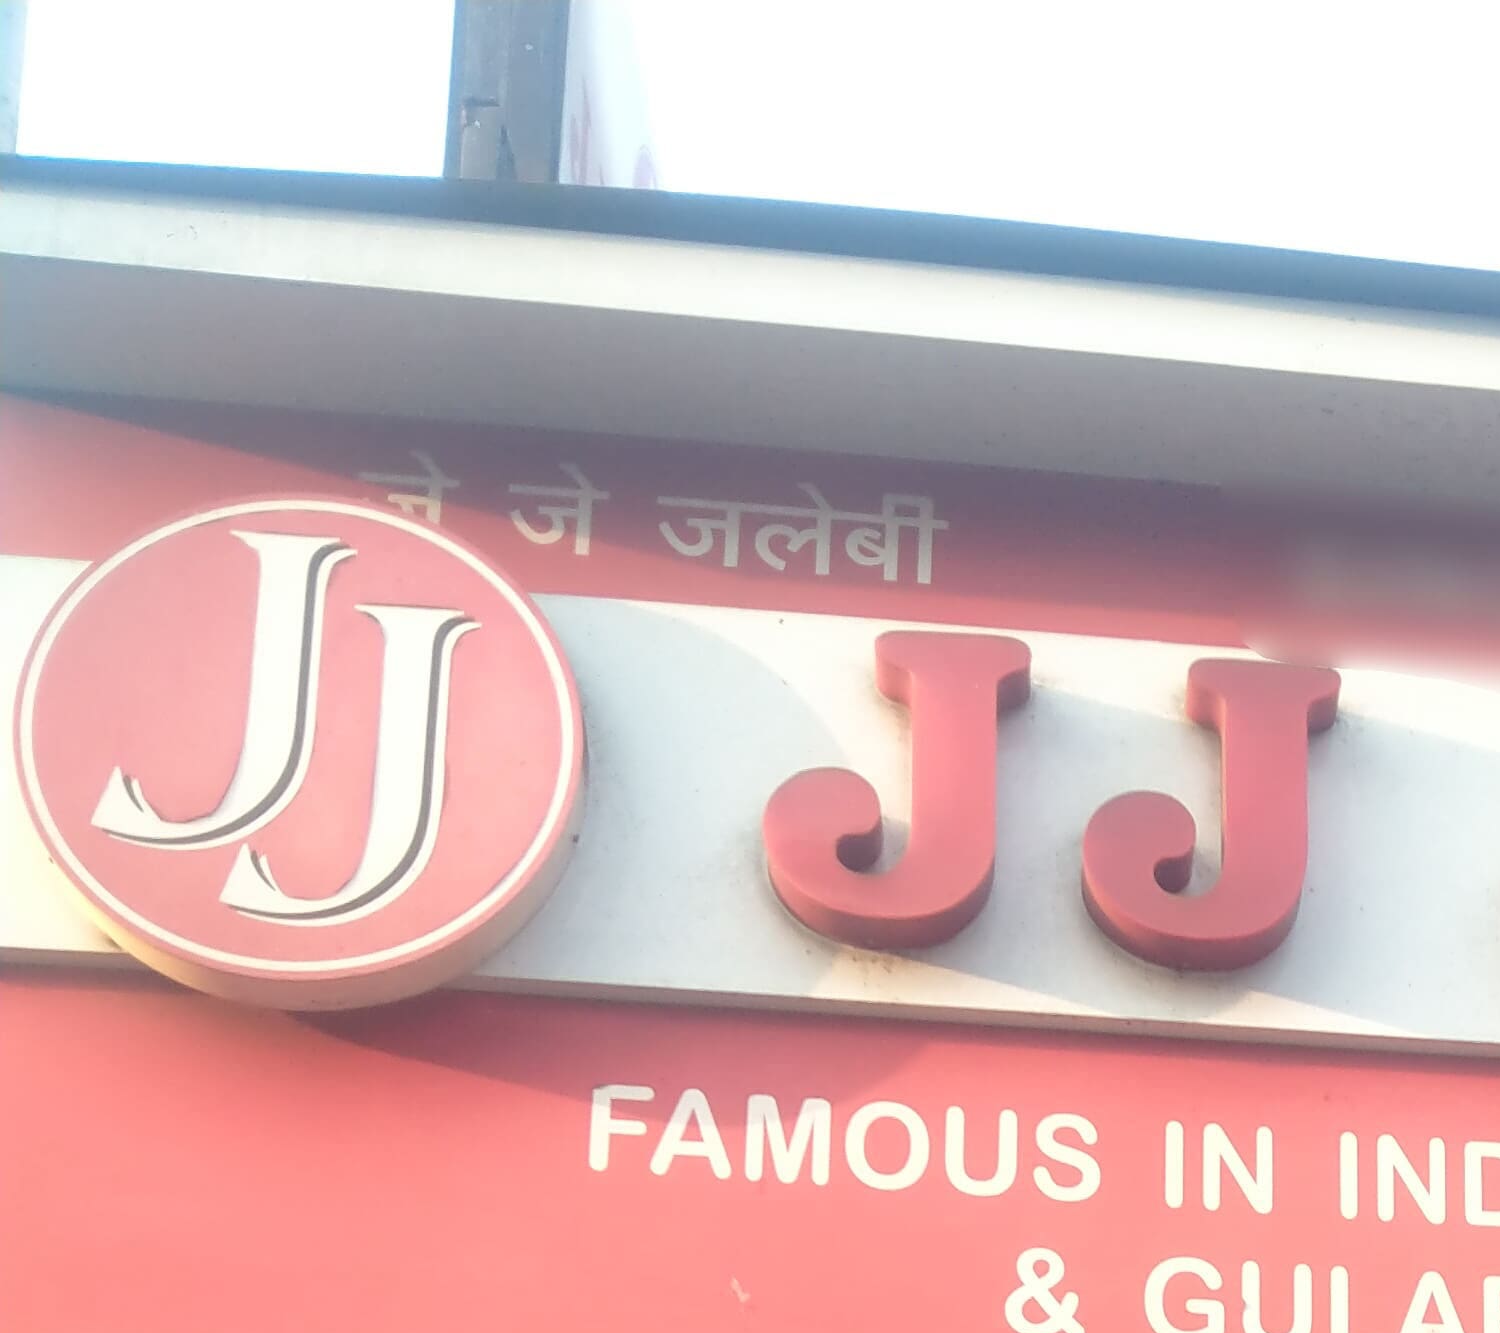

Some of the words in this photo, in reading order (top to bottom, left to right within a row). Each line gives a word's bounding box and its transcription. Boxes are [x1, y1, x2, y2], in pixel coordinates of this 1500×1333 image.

[508, 463, 608, 556] जे
[656, 481, 950, 585] जलेबी
[762, 629, 1342, 972] JJ
[588, 1084, 1103, 1203] FAMOUS
[1164, 1120, 1275, 1215] IN
